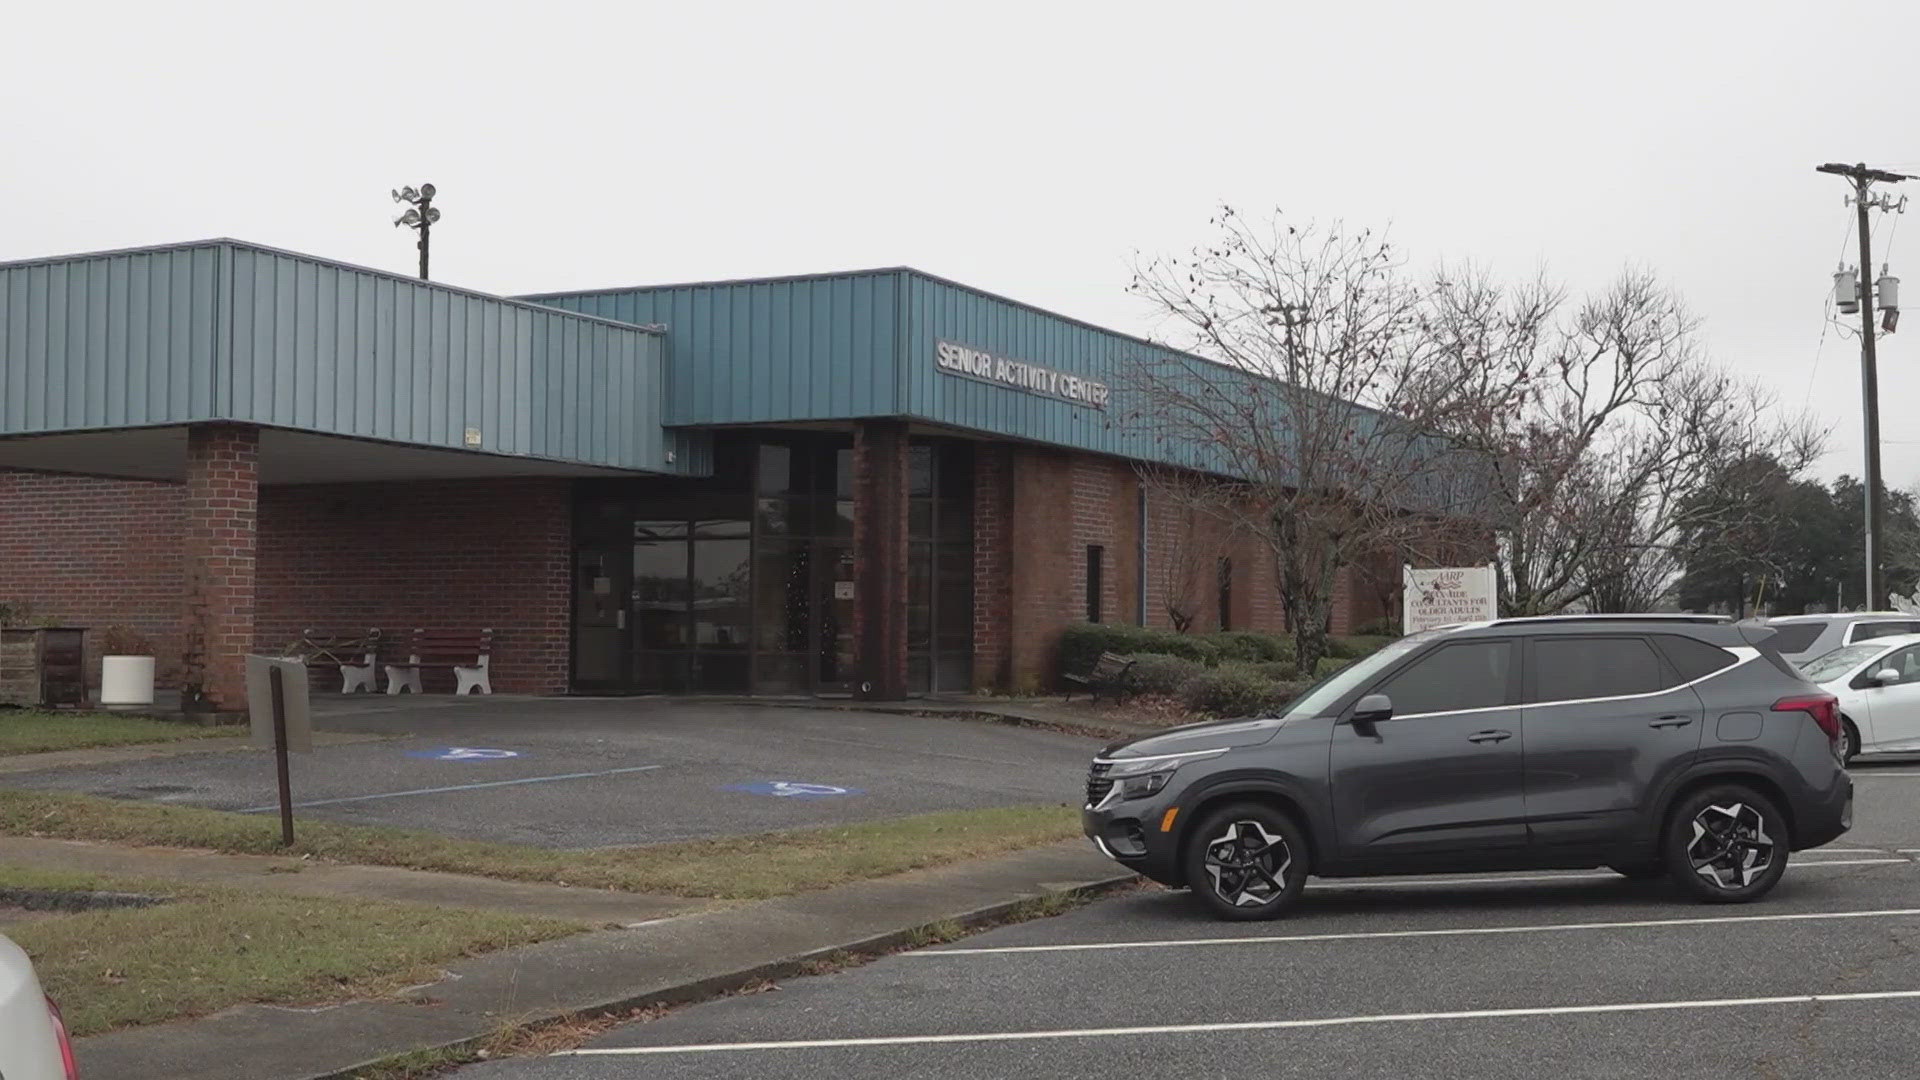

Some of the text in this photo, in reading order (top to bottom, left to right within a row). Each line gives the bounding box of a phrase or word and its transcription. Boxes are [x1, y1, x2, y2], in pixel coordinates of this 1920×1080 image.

[937, 341, 1109, 407] SENIOR ACTIVITY CENTER
[1431, 589, 1467, 599] AX-AIDE
[1470, 597, 1487, 606] FOR
[1418, 607, 1481, 616] OLDER ADULTS
